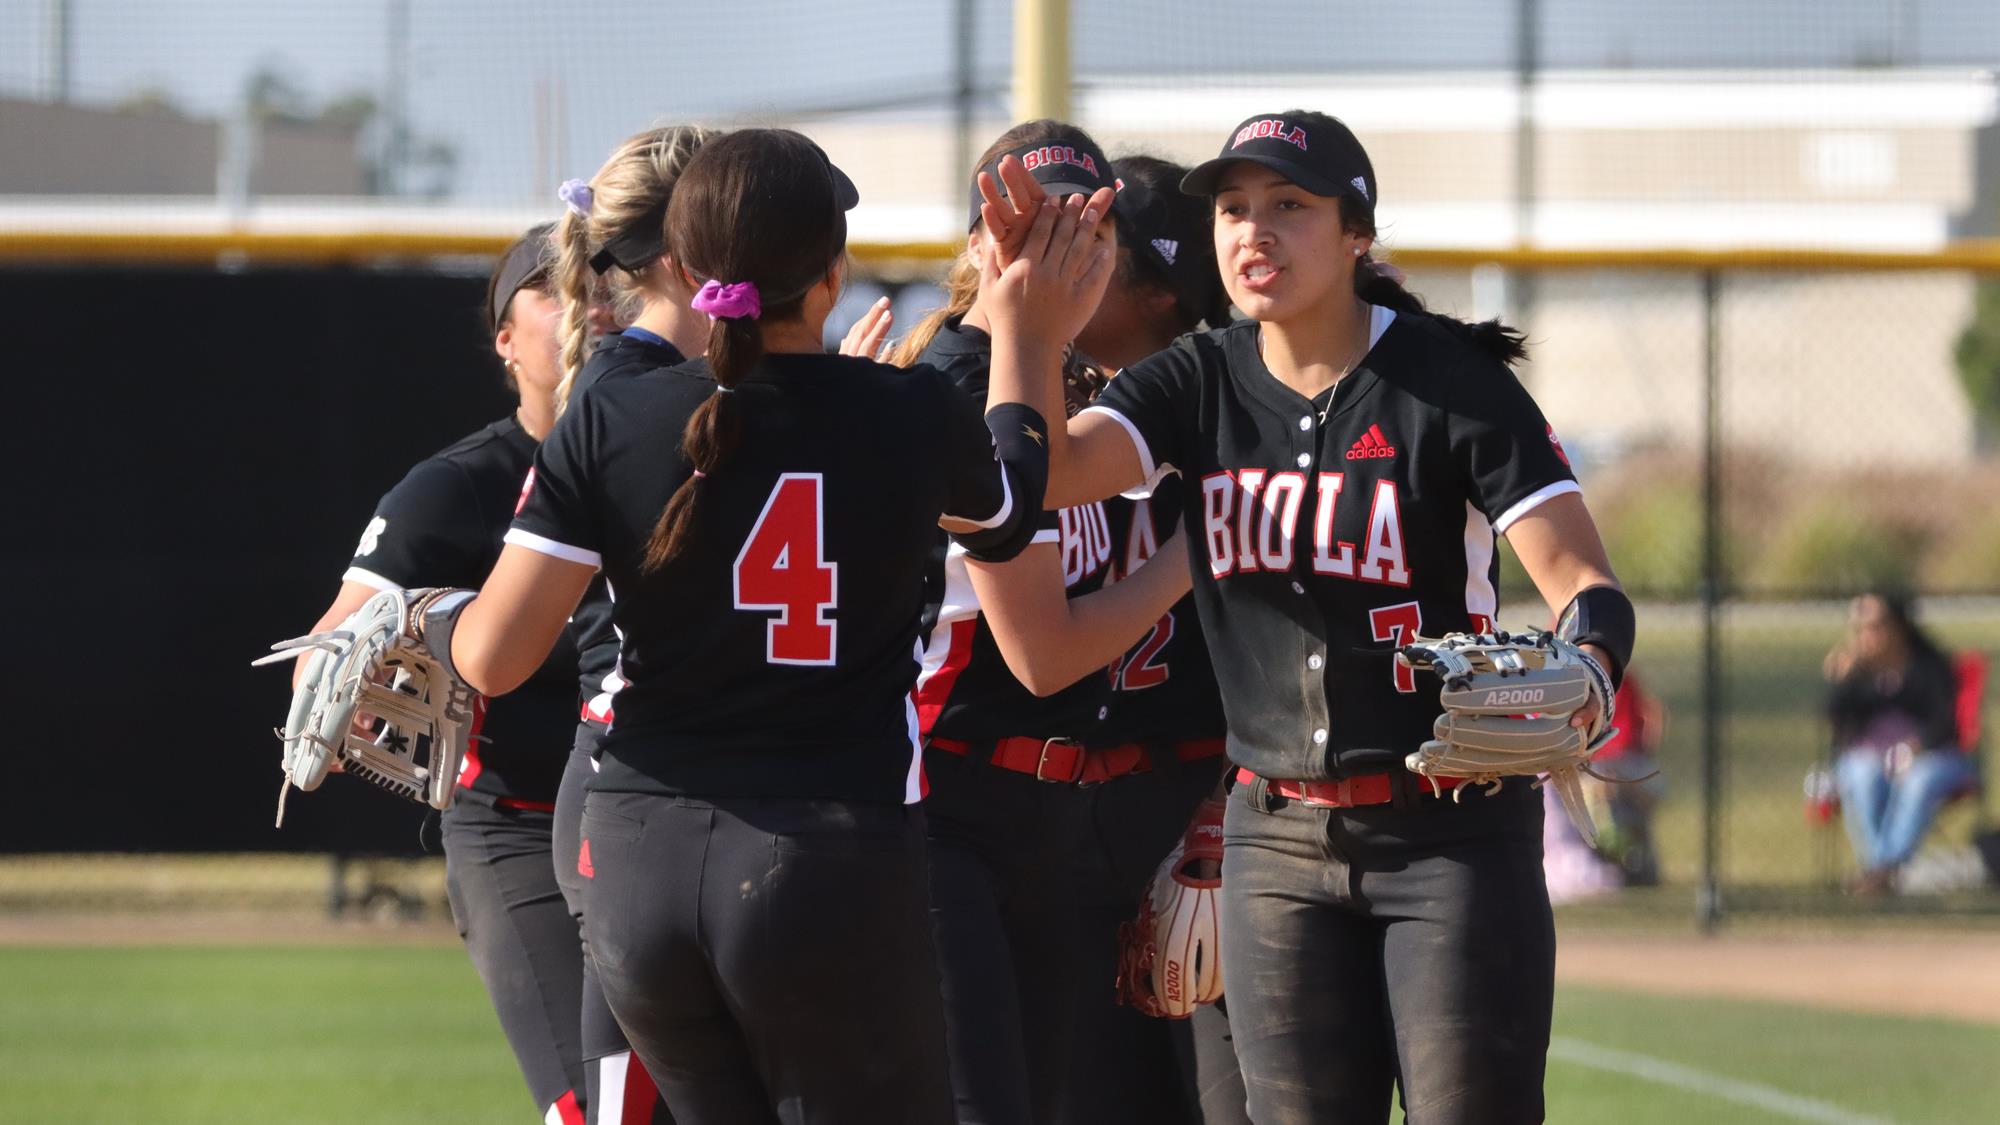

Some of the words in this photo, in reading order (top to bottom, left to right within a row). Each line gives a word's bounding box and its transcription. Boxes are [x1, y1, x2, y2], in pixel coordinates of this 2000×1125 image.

[1231, 119, 1307, 151] BIOLA
[1022, 145, 1099, 178] BIOLA
[1346, 446, 1395, 460] adidas
[1202, 468, 1412, 587] BIOLA
[733, 472, 838, 667] 4
[1108, 610, 1176, 691] 2
[1368, 601, 1422, 693] 7
[1484, 688, 1544, 706] A2000
[1166, 960, 1182, 1002] A2000
